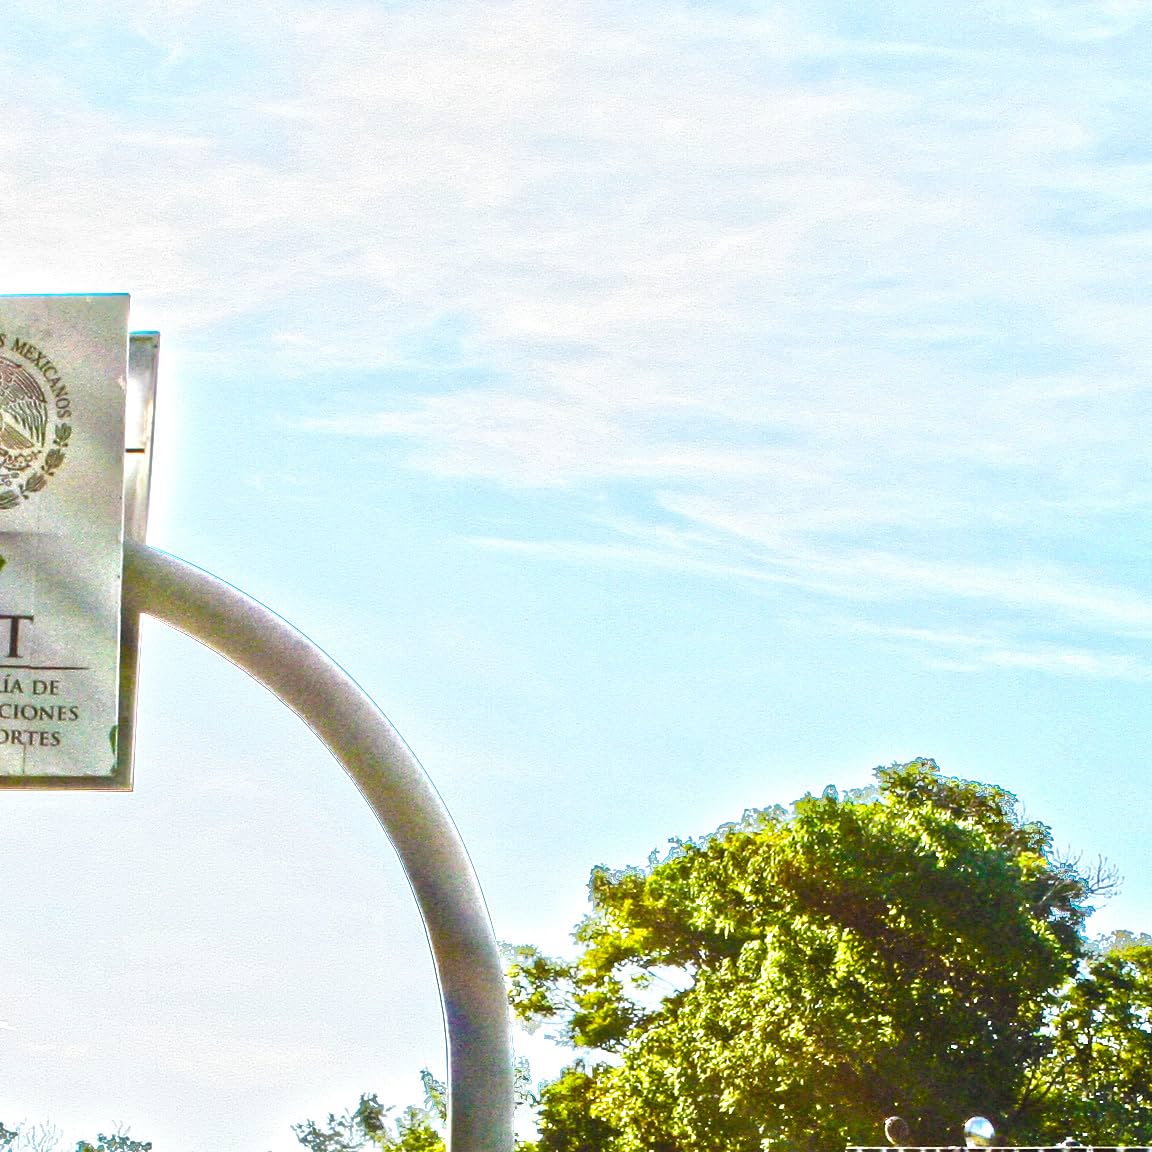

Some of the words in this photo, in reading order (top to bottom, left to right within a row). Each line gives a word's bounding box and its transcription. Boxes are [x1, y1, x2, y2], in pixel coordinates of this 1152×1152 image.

[11, 337, 72, 419] MEXICANOS
[0, 673, 24, 693] ÍA
[32, 680, 60, 695] DE
[0, 704, 79, 721] CIONES
